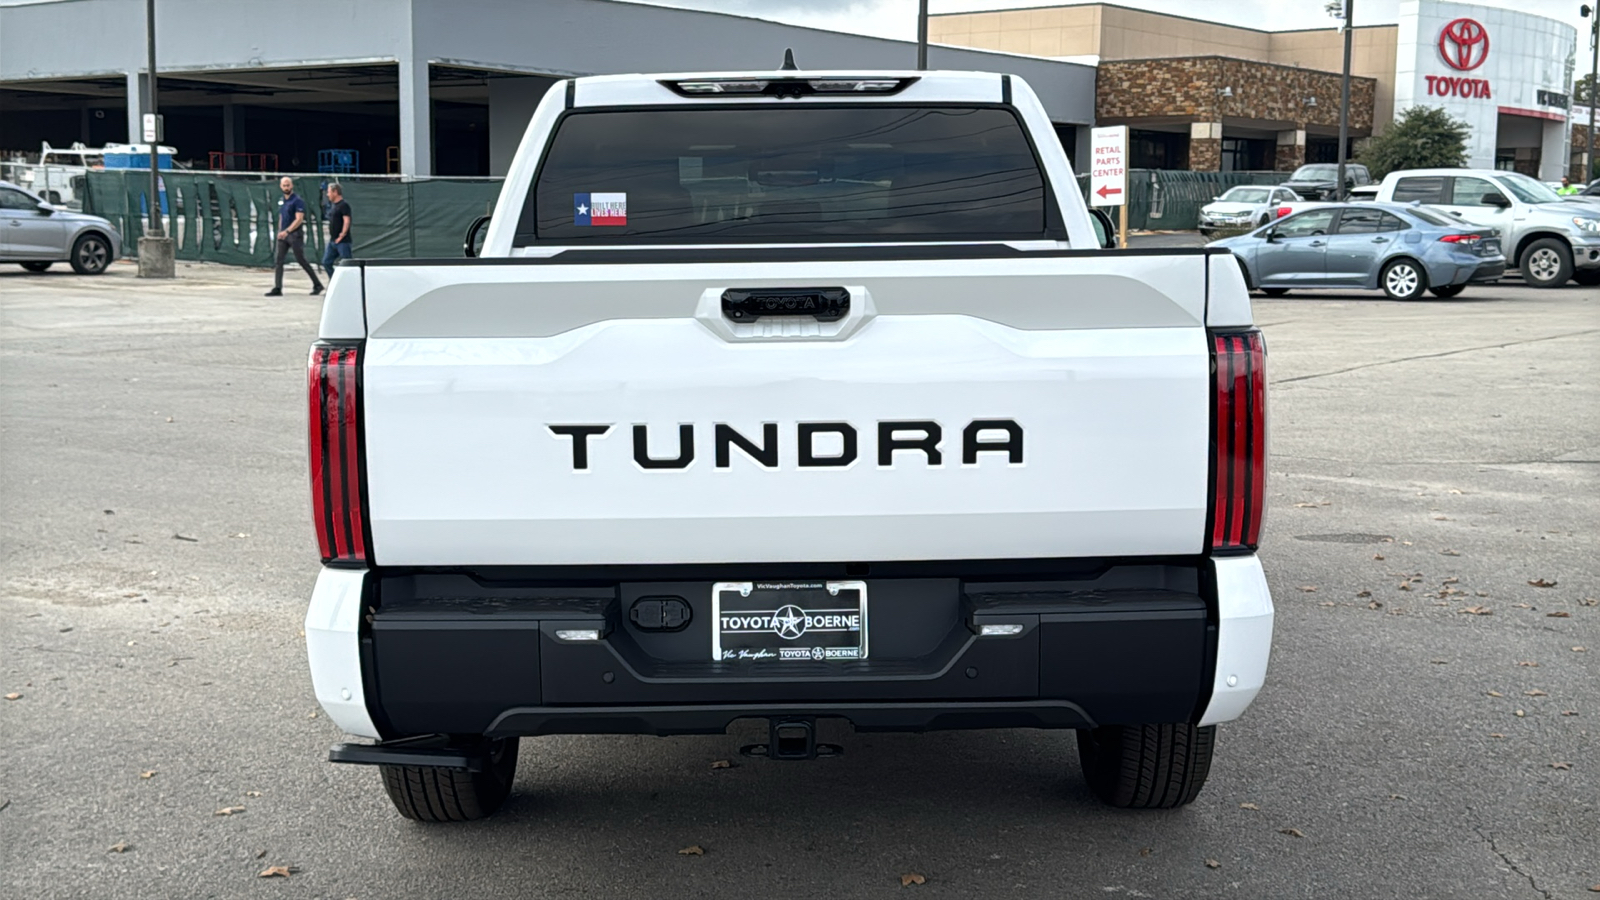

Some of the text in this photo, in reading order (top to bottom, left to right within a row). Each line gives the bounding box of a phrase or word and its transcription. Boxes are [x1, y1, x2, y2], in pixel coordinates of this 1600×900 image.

[1425, 75, 1491, 99] TOYOTA
[1095, 146, 1121, 155] RETAIL
[1096, 157, 1120, 166] PARTS
[1092, 168, 1124, 177] CENTER
[610, 209, 626, 217] HERE
[756, 296, 816, 310] TOYOTA
[544, 417, 1026, 472] TUNDRA
[721, 616, 780, 629] TOYOTA
[805, 615, 860, 628] BOERNE
[780, 650, 811, 658] TOYOTA
